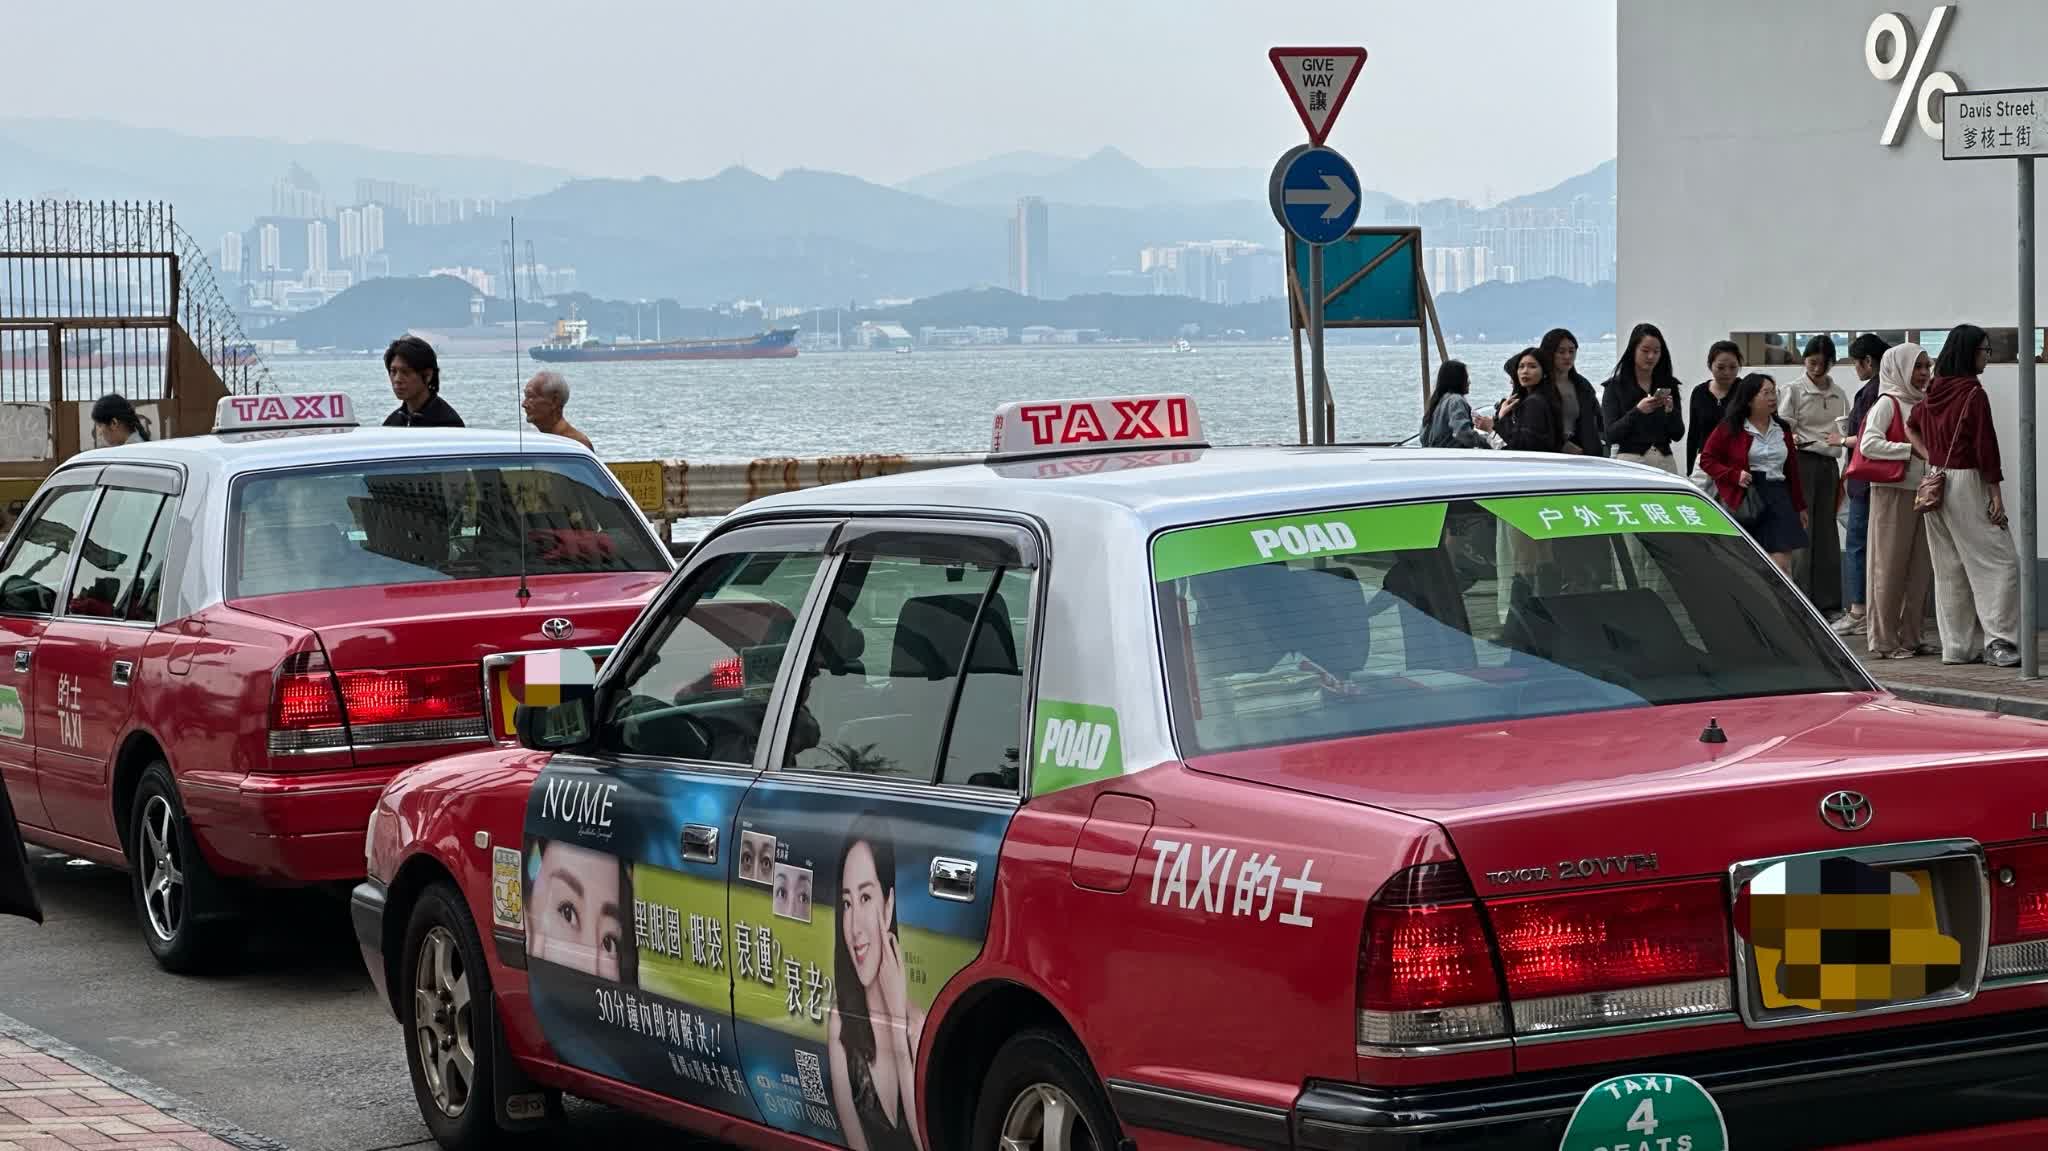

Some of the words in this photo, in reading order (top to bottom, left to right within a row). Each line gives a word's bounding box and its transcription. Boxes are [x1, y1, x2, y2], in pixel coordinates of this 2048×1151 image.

[1302, 58, 1334, 71] GIVE
[1303, 74, 1334, 87] WAY
[1309, 90, 1327, 111] 讓
[1960, 102, 1991, 118] Davis
[1997, 100, 2035, 117] Street
[1963, 125, 2031, 149] 爹核士街
[232, 395, 344, 421] TAXI
[1021, 399, 1190, 445] TAXI
[1538, 503, 1706, 530] 户外无限度
[1251, 522, 1357, 558] POAD
[57, 673, 81, 710] 的士
[58, 710, 82, 748] TAXI
[1040, 718, 1111, 770] POAD
[541, 777, 618, 827] NUME
[1486, 867, 1551, 884] TOYOTA
[1605, 1077, 1672, 1099] TAXI
[806, 1103, 836, 1130] 0880
[1627, 1098, 1658, 1135] 4
[1593, 1135, 1693, 1151] ATS
